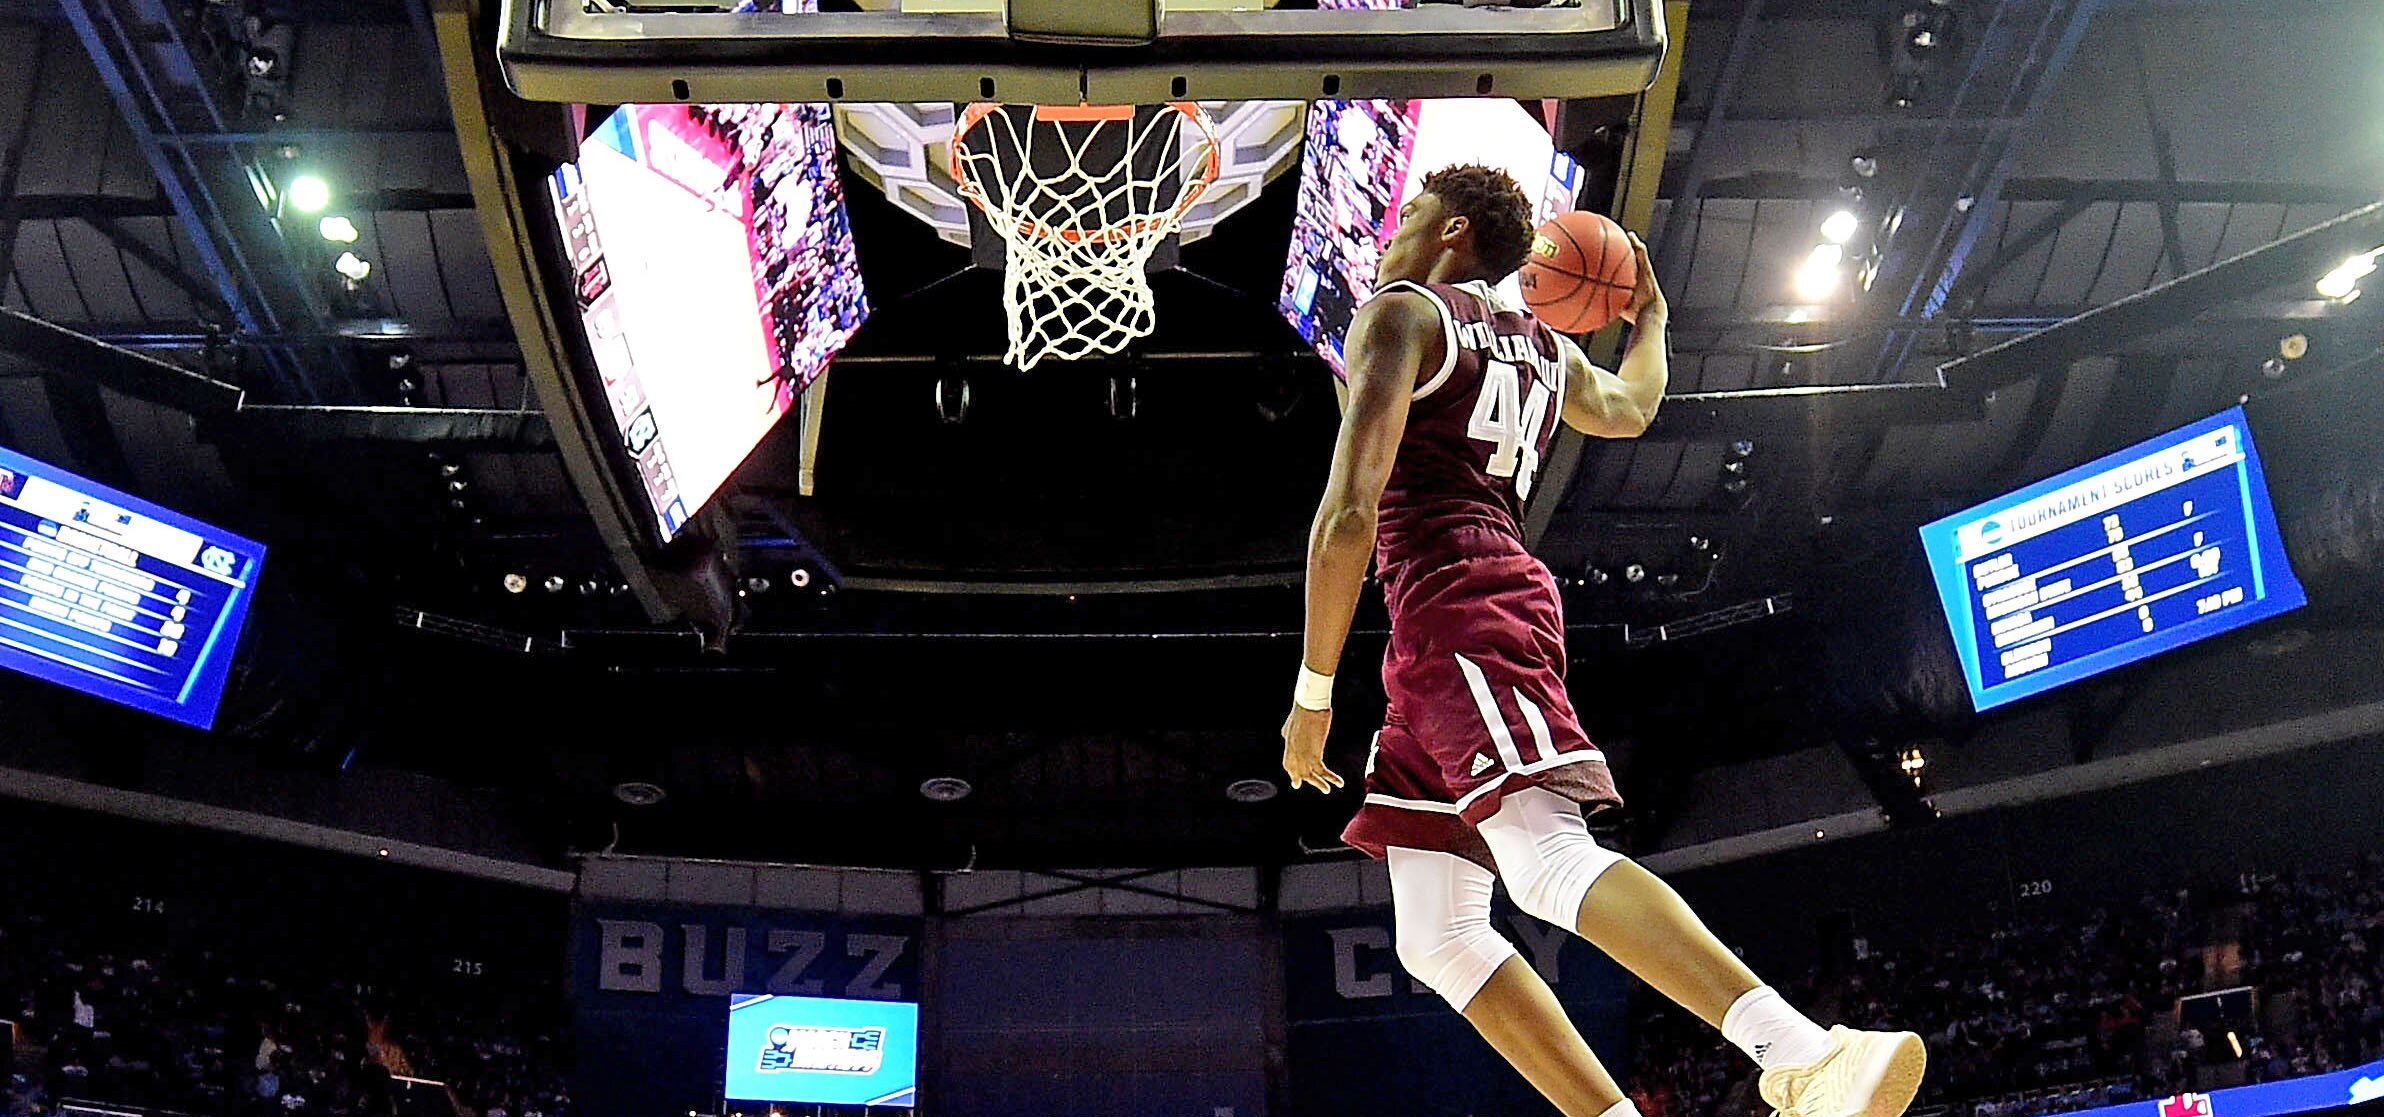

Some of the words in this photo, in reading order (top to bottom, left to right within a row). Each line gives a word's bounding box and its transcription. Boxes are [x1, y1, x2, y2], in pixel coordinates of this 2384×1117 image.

[1467, 359, 1550, 501] 44
[2010, 483, 2108, 533] TOURNAMENT
[2114, 460, 2174, 495] SCORES
[133, 896, 164, 914] 214
[2020, 880, 2052, 897] 220
[453, 958, 483, 975] 215
[597, 918, 909, 1000] BUZZ
[1325, 915, 1569, 998] CY
